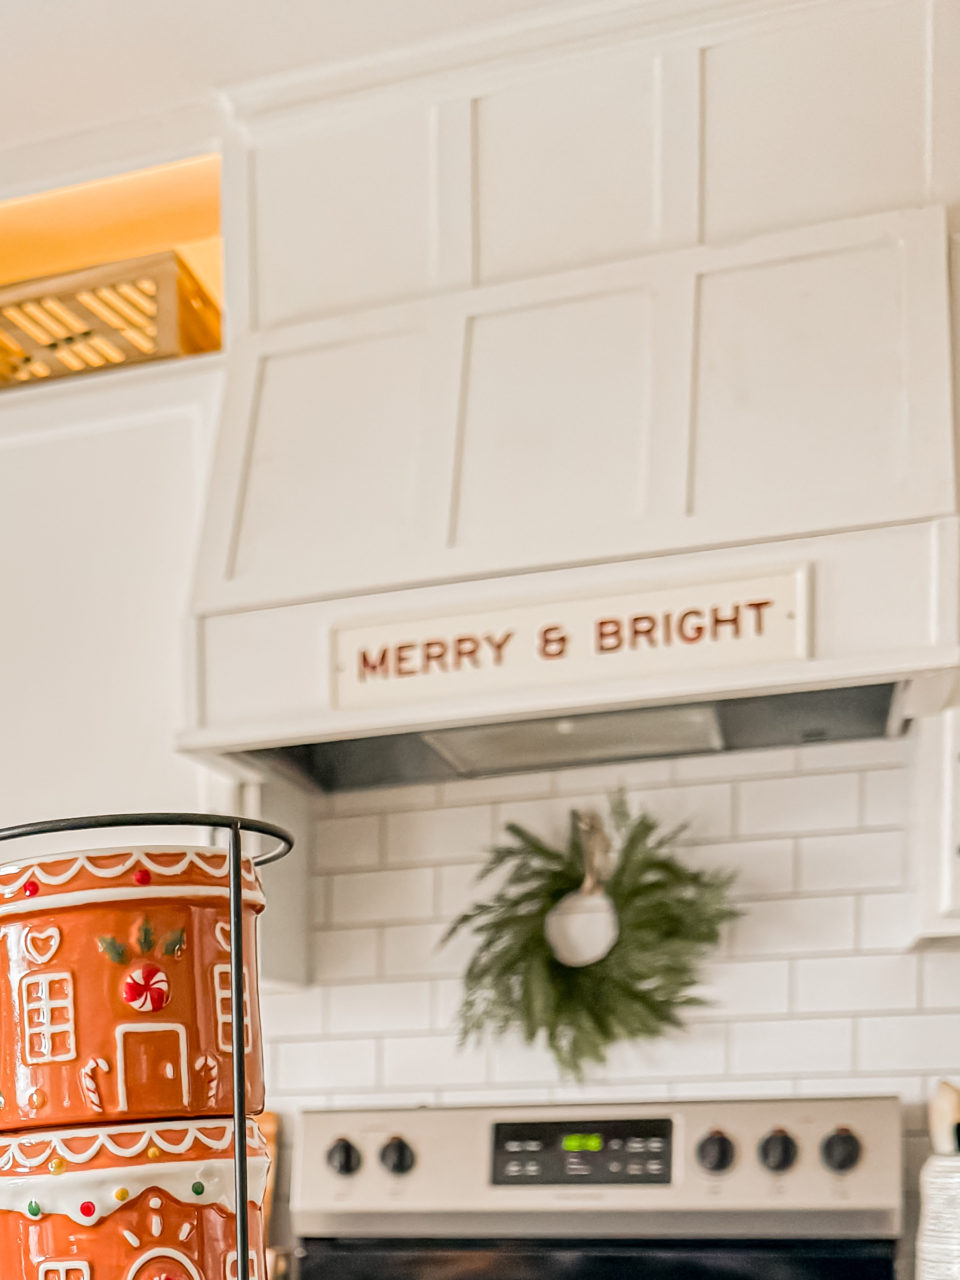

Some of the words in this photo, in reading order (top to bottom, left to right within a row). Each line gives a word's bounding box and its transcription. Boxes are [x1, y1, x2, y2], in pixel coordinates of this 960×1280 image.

[357, 631, 515, 682] MERRY
[537, 624, 571, 661] &
[594, 600, 774, 655] BRIGHT
